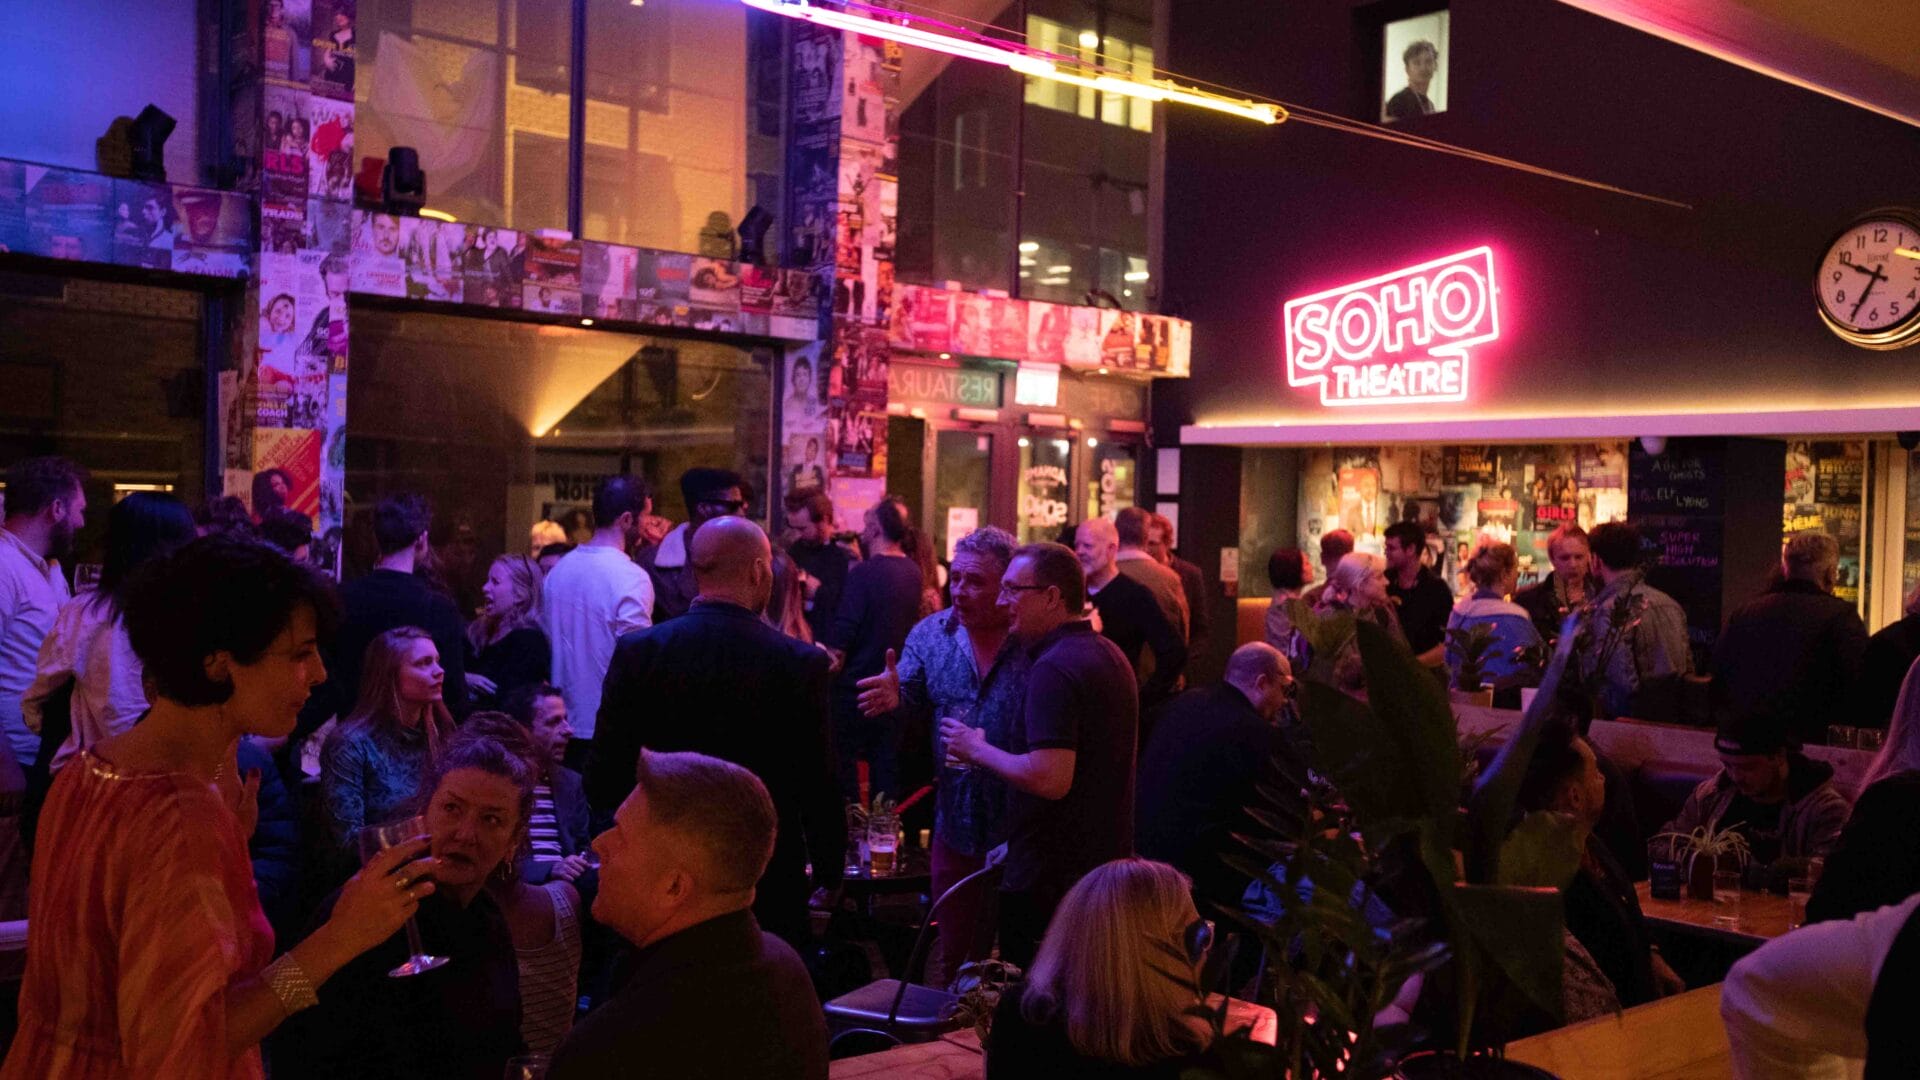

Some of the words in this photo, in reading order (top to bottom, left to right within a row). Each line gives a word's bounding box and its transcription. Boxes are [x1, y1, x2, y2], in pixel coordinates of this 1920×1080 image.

[1856, 235, 1866, 249] 11
[1873, 229, 1888, 243] 12
[1839, 251, 1852, 265] 10
[1833, 271, 1842, 283] 9
[1836, 290, 1845, 303] 8
[1906, 287, 1917, 300] 4
[1869, 308, 1878, 321] 6
[1890, 302, 1899, 315] 5
[1295, 264, 1486, 370] SOHO
[1332, 359, 1461, 398] THEATRE
[257, 408, 288, 418] COACH
[1536, 505, 1576, 519] GIRLS
